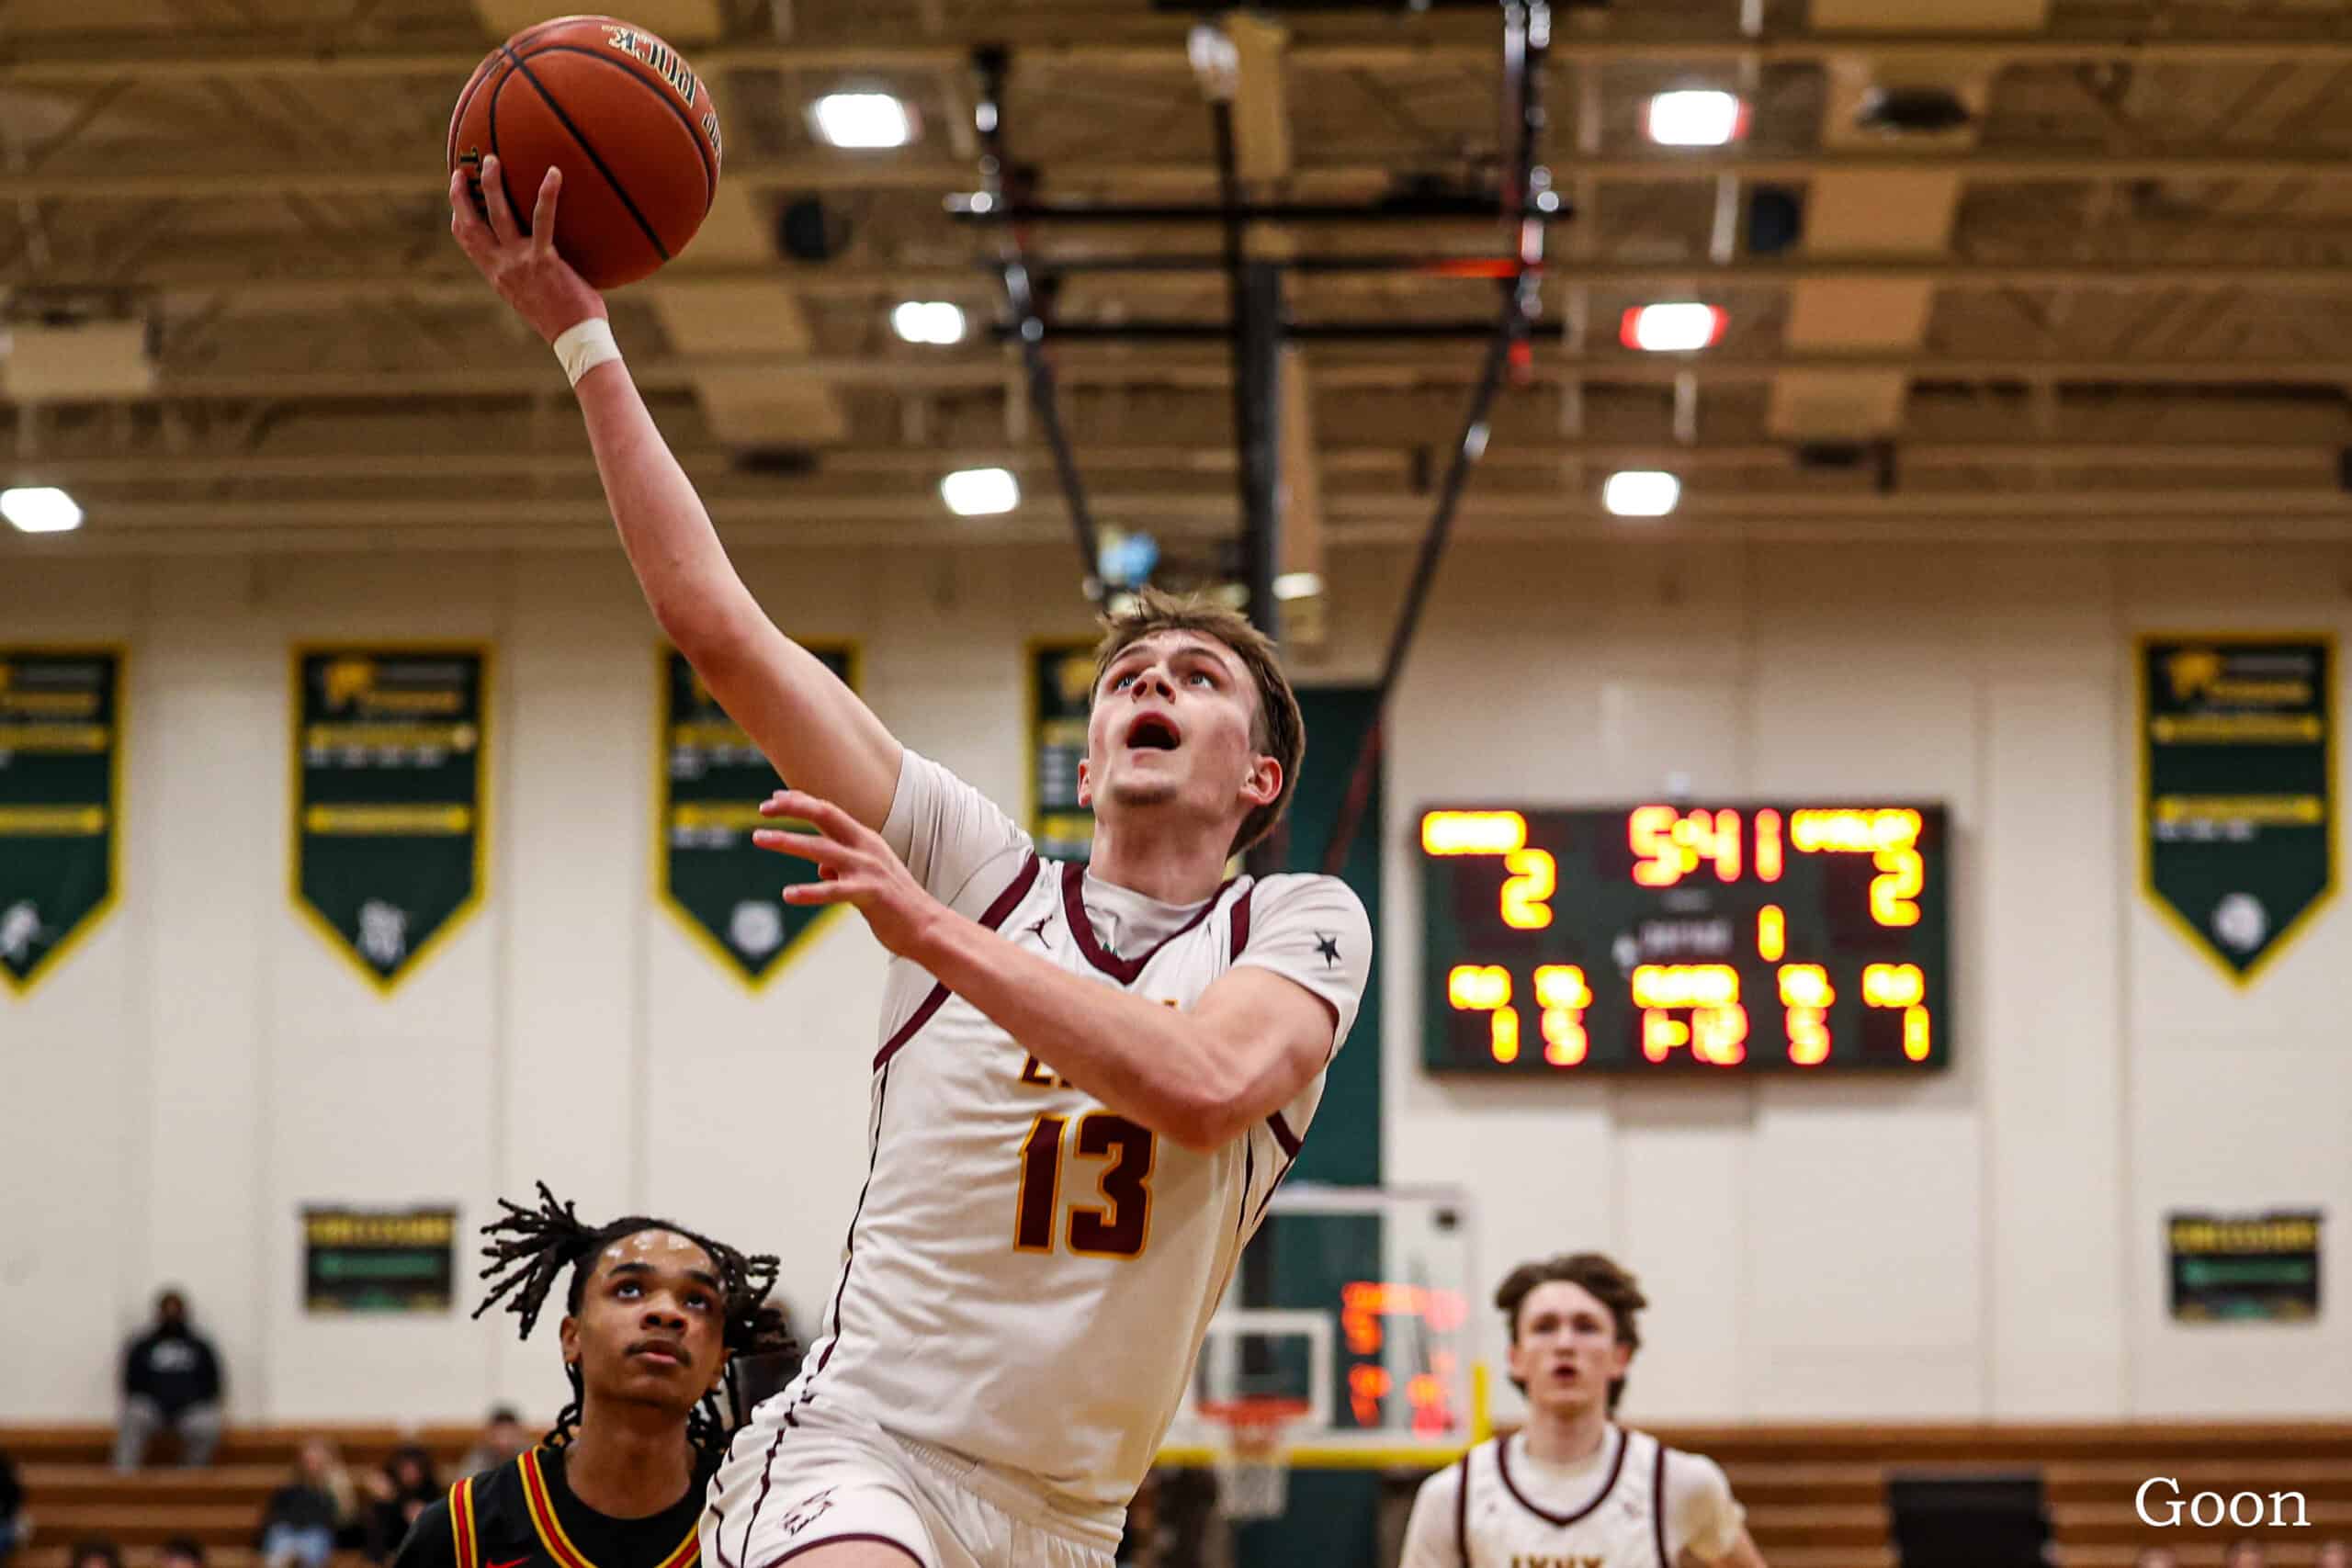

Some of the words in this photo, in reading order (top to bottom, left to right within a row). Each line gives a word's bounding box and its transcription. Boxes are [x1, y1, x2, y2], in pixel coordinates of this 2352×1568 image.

[1500, 848, 1556, 930] 2
[1871, 847, 1923, 927] 2
[1758, 904, 1785, 962] 1
[1013, 1110, 1158, 1261] 13
